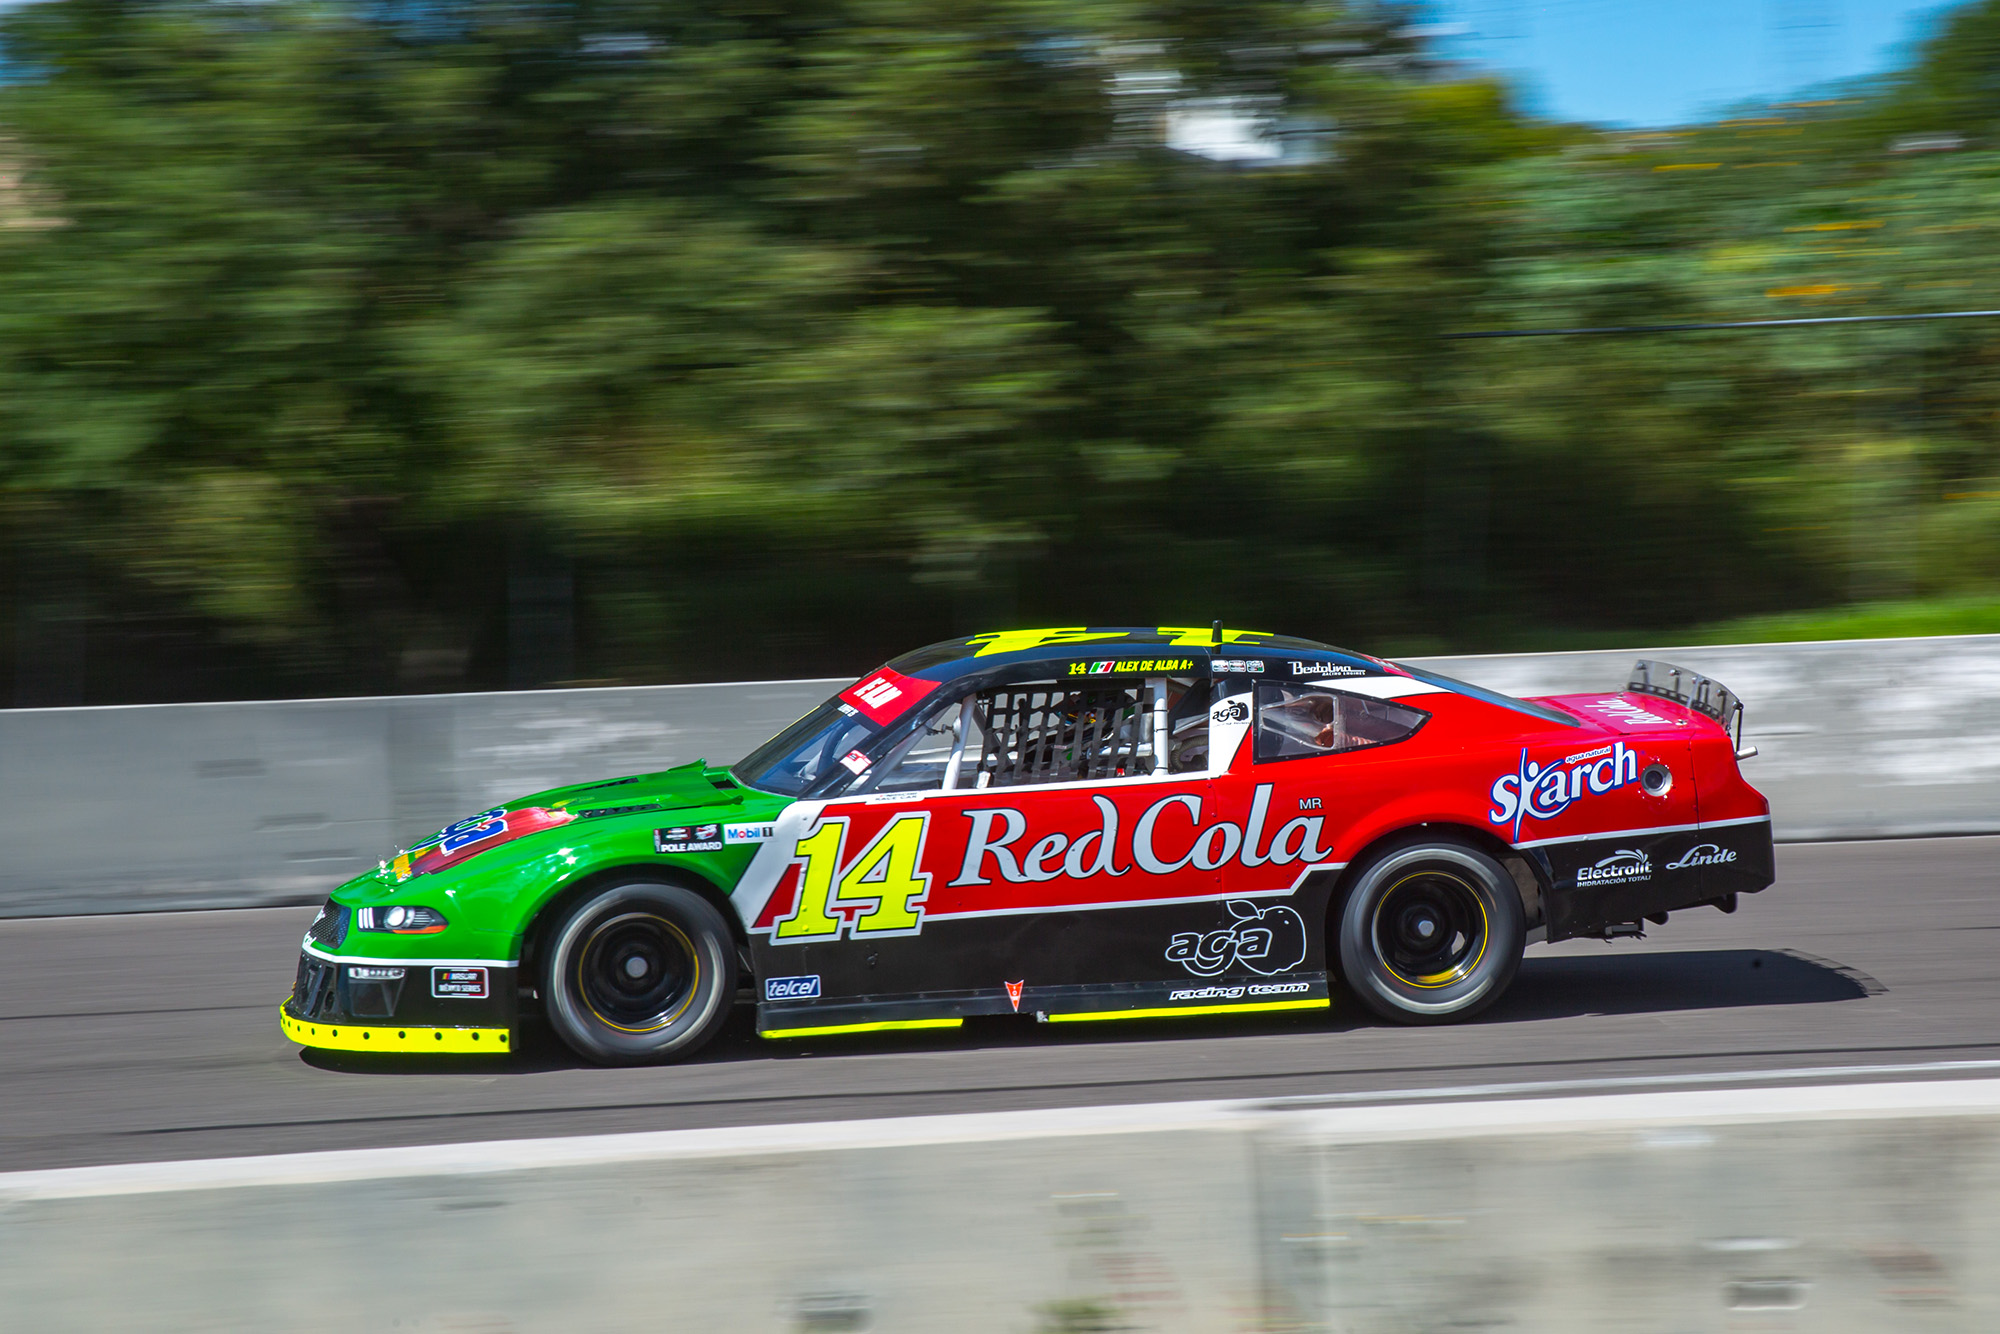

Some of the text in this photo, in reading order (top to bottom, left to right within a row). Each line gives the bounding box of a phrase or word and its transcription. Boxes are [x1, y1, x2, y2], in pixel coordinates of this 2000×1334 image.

[1068, 663, 1086, 675] 14
[1114, 660, 1193, 673] ALEX DE ALBA A+
[1288, 661, 1365, 675] Bertolina
[1212, 708, 1240, 722] aga
[1565, 745, 1611, 763] agua natural
[1299, 798, 1322, 810] MR
[728, 828, 760, 839] Mobil
[762, 827, 774, 837] 1
[948, 783, 1334, 888] Red Cola
[661, 841, 722, 853] POLE AWARD
[1666, 844, 1737, 870] Linde
[769, 810, 932, 945] 14
[1577, 861, 1652, 881] Electrolit
[1165, 928, 1272, 977] aga
[769, 979, 817, 997] telcel
[1169, 983, 1310, 1000] racing team
